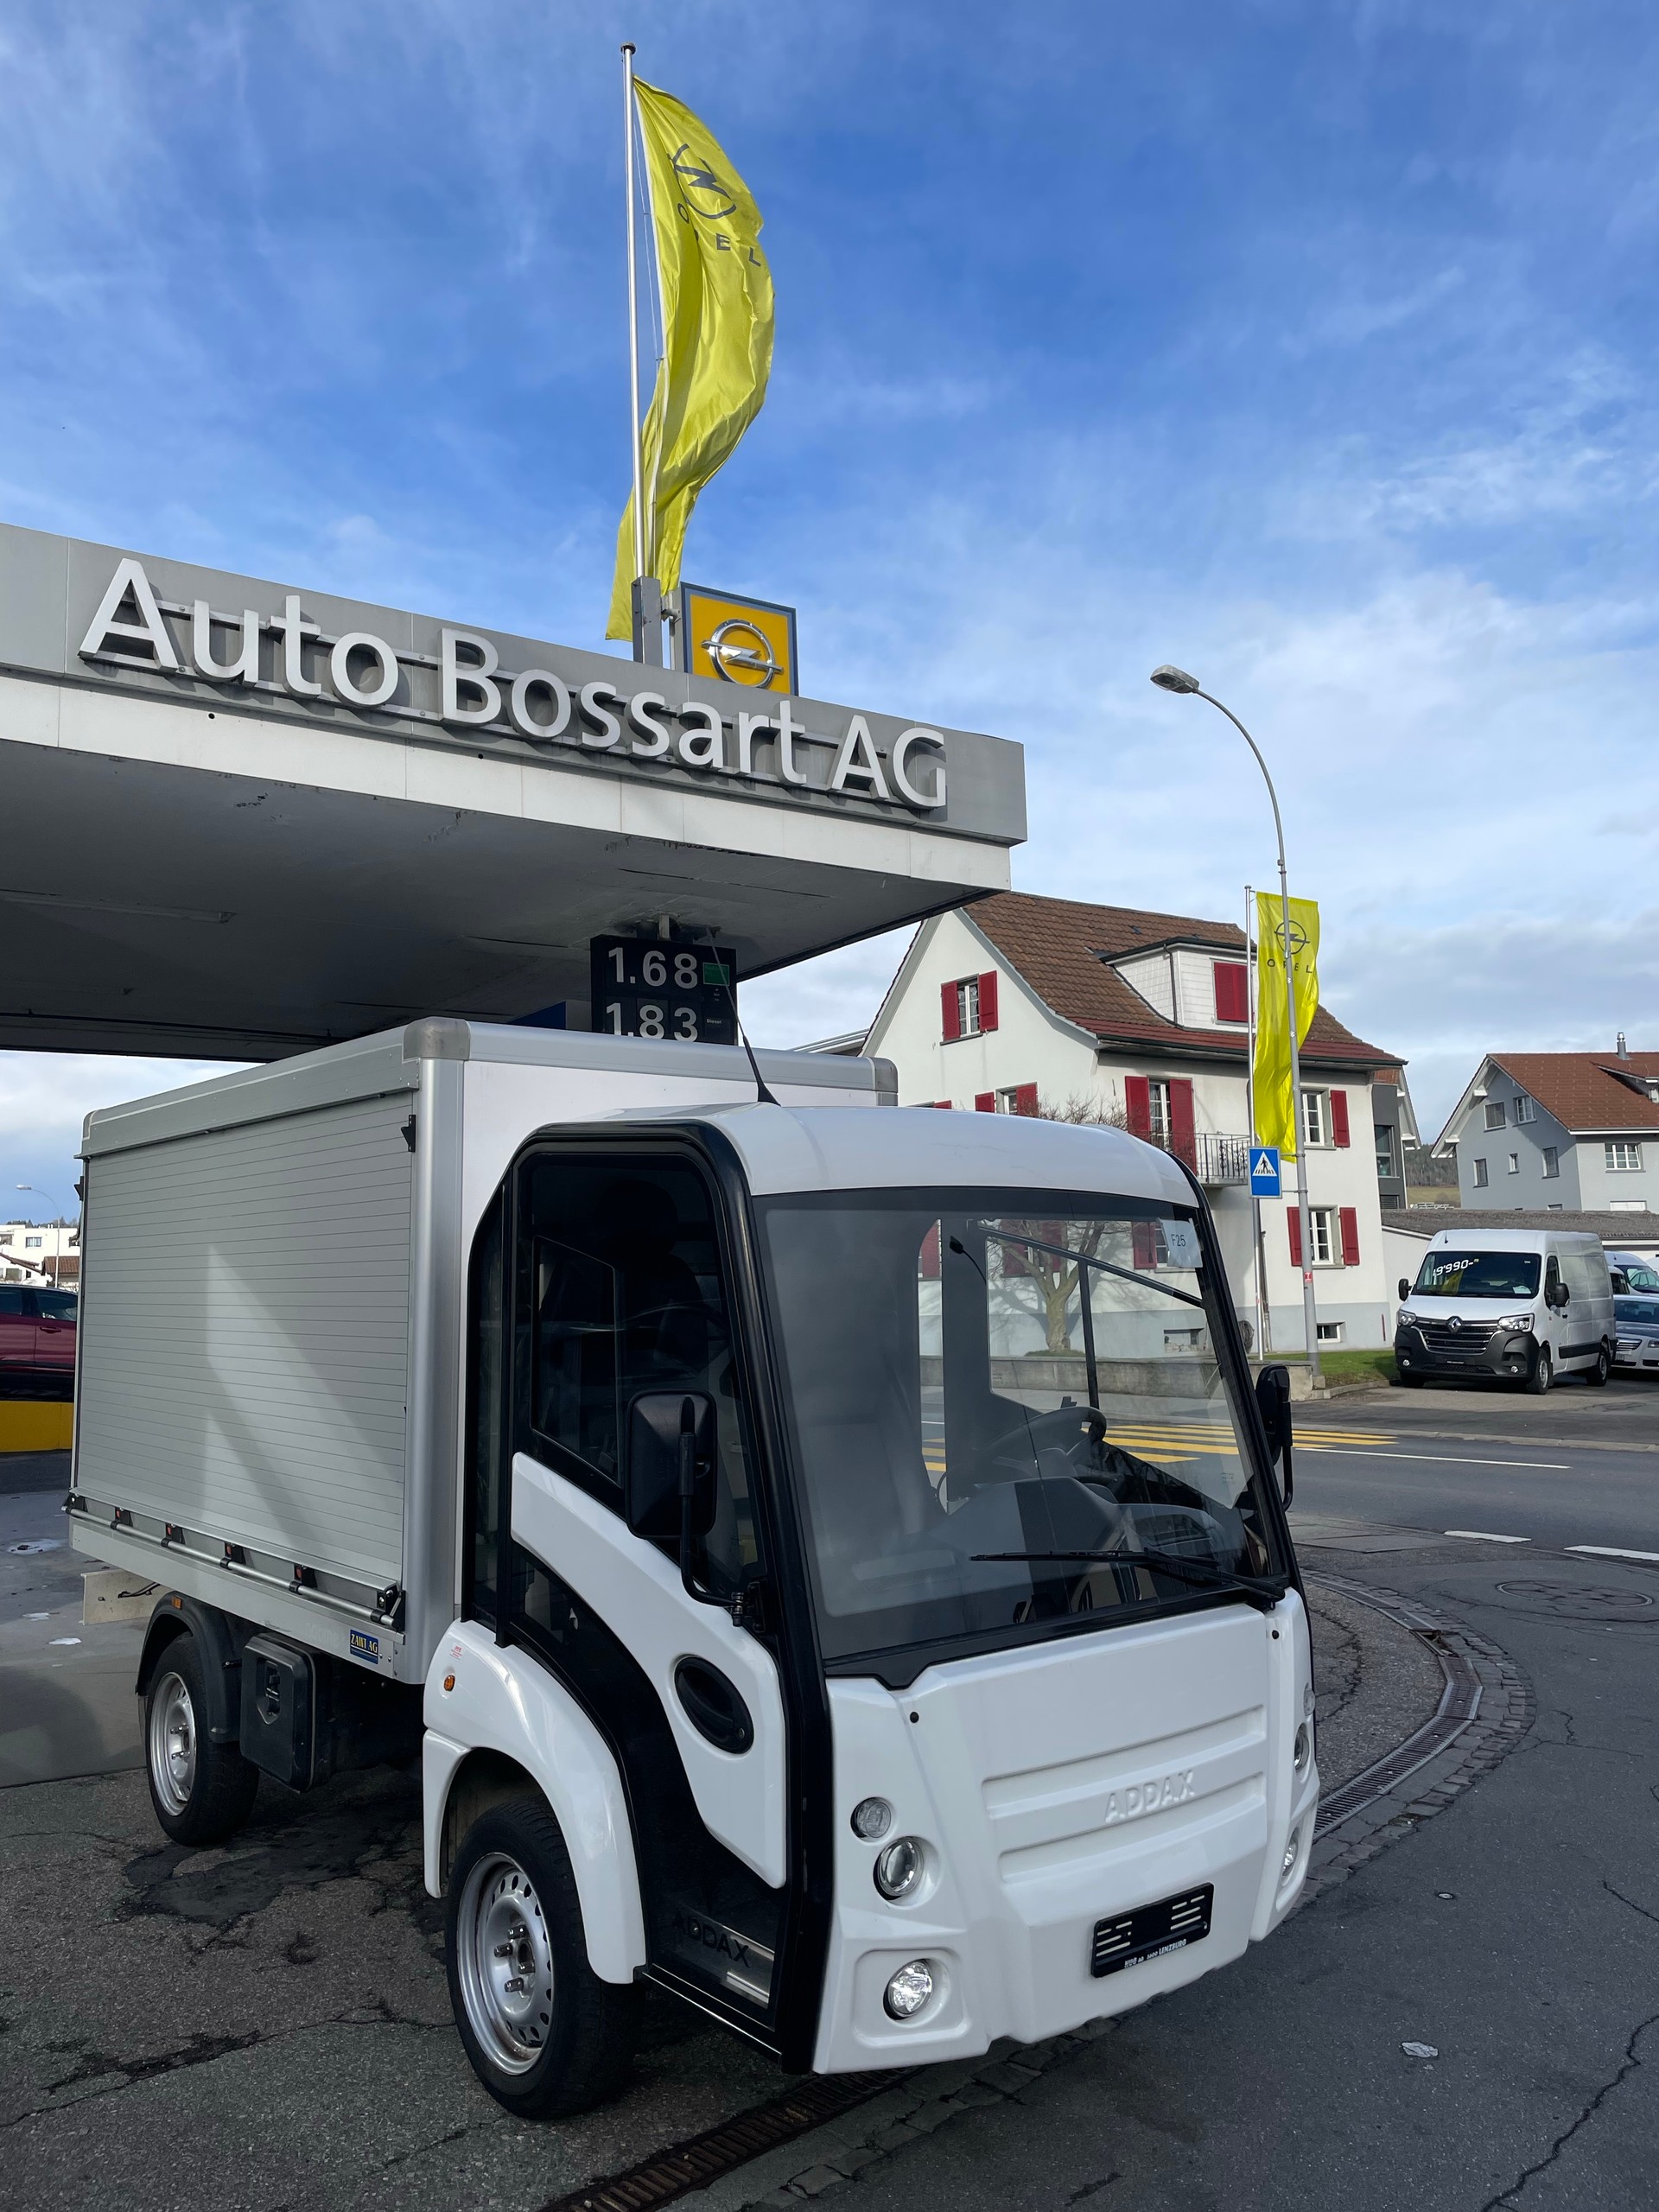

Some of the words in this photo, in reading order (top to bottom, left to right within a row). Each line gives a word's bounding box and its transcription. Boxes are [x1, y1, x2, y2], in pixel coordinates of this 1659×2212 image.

[677, 202, 761, 268] OEL
[78, 557, 400, 707] Auto
[438, 627, 807, 786] Bossart
[826, 715, 947, 810] AG
[607, 946, 698, 989] 1.68
[606, 1002, 698, 1042] 1.83
[1170, 1233, 1186, 1247] F25
[1104, 1769, 1195, 1823] ADDAX
[1159, 1938, 1187, 1955] LENZBURG
